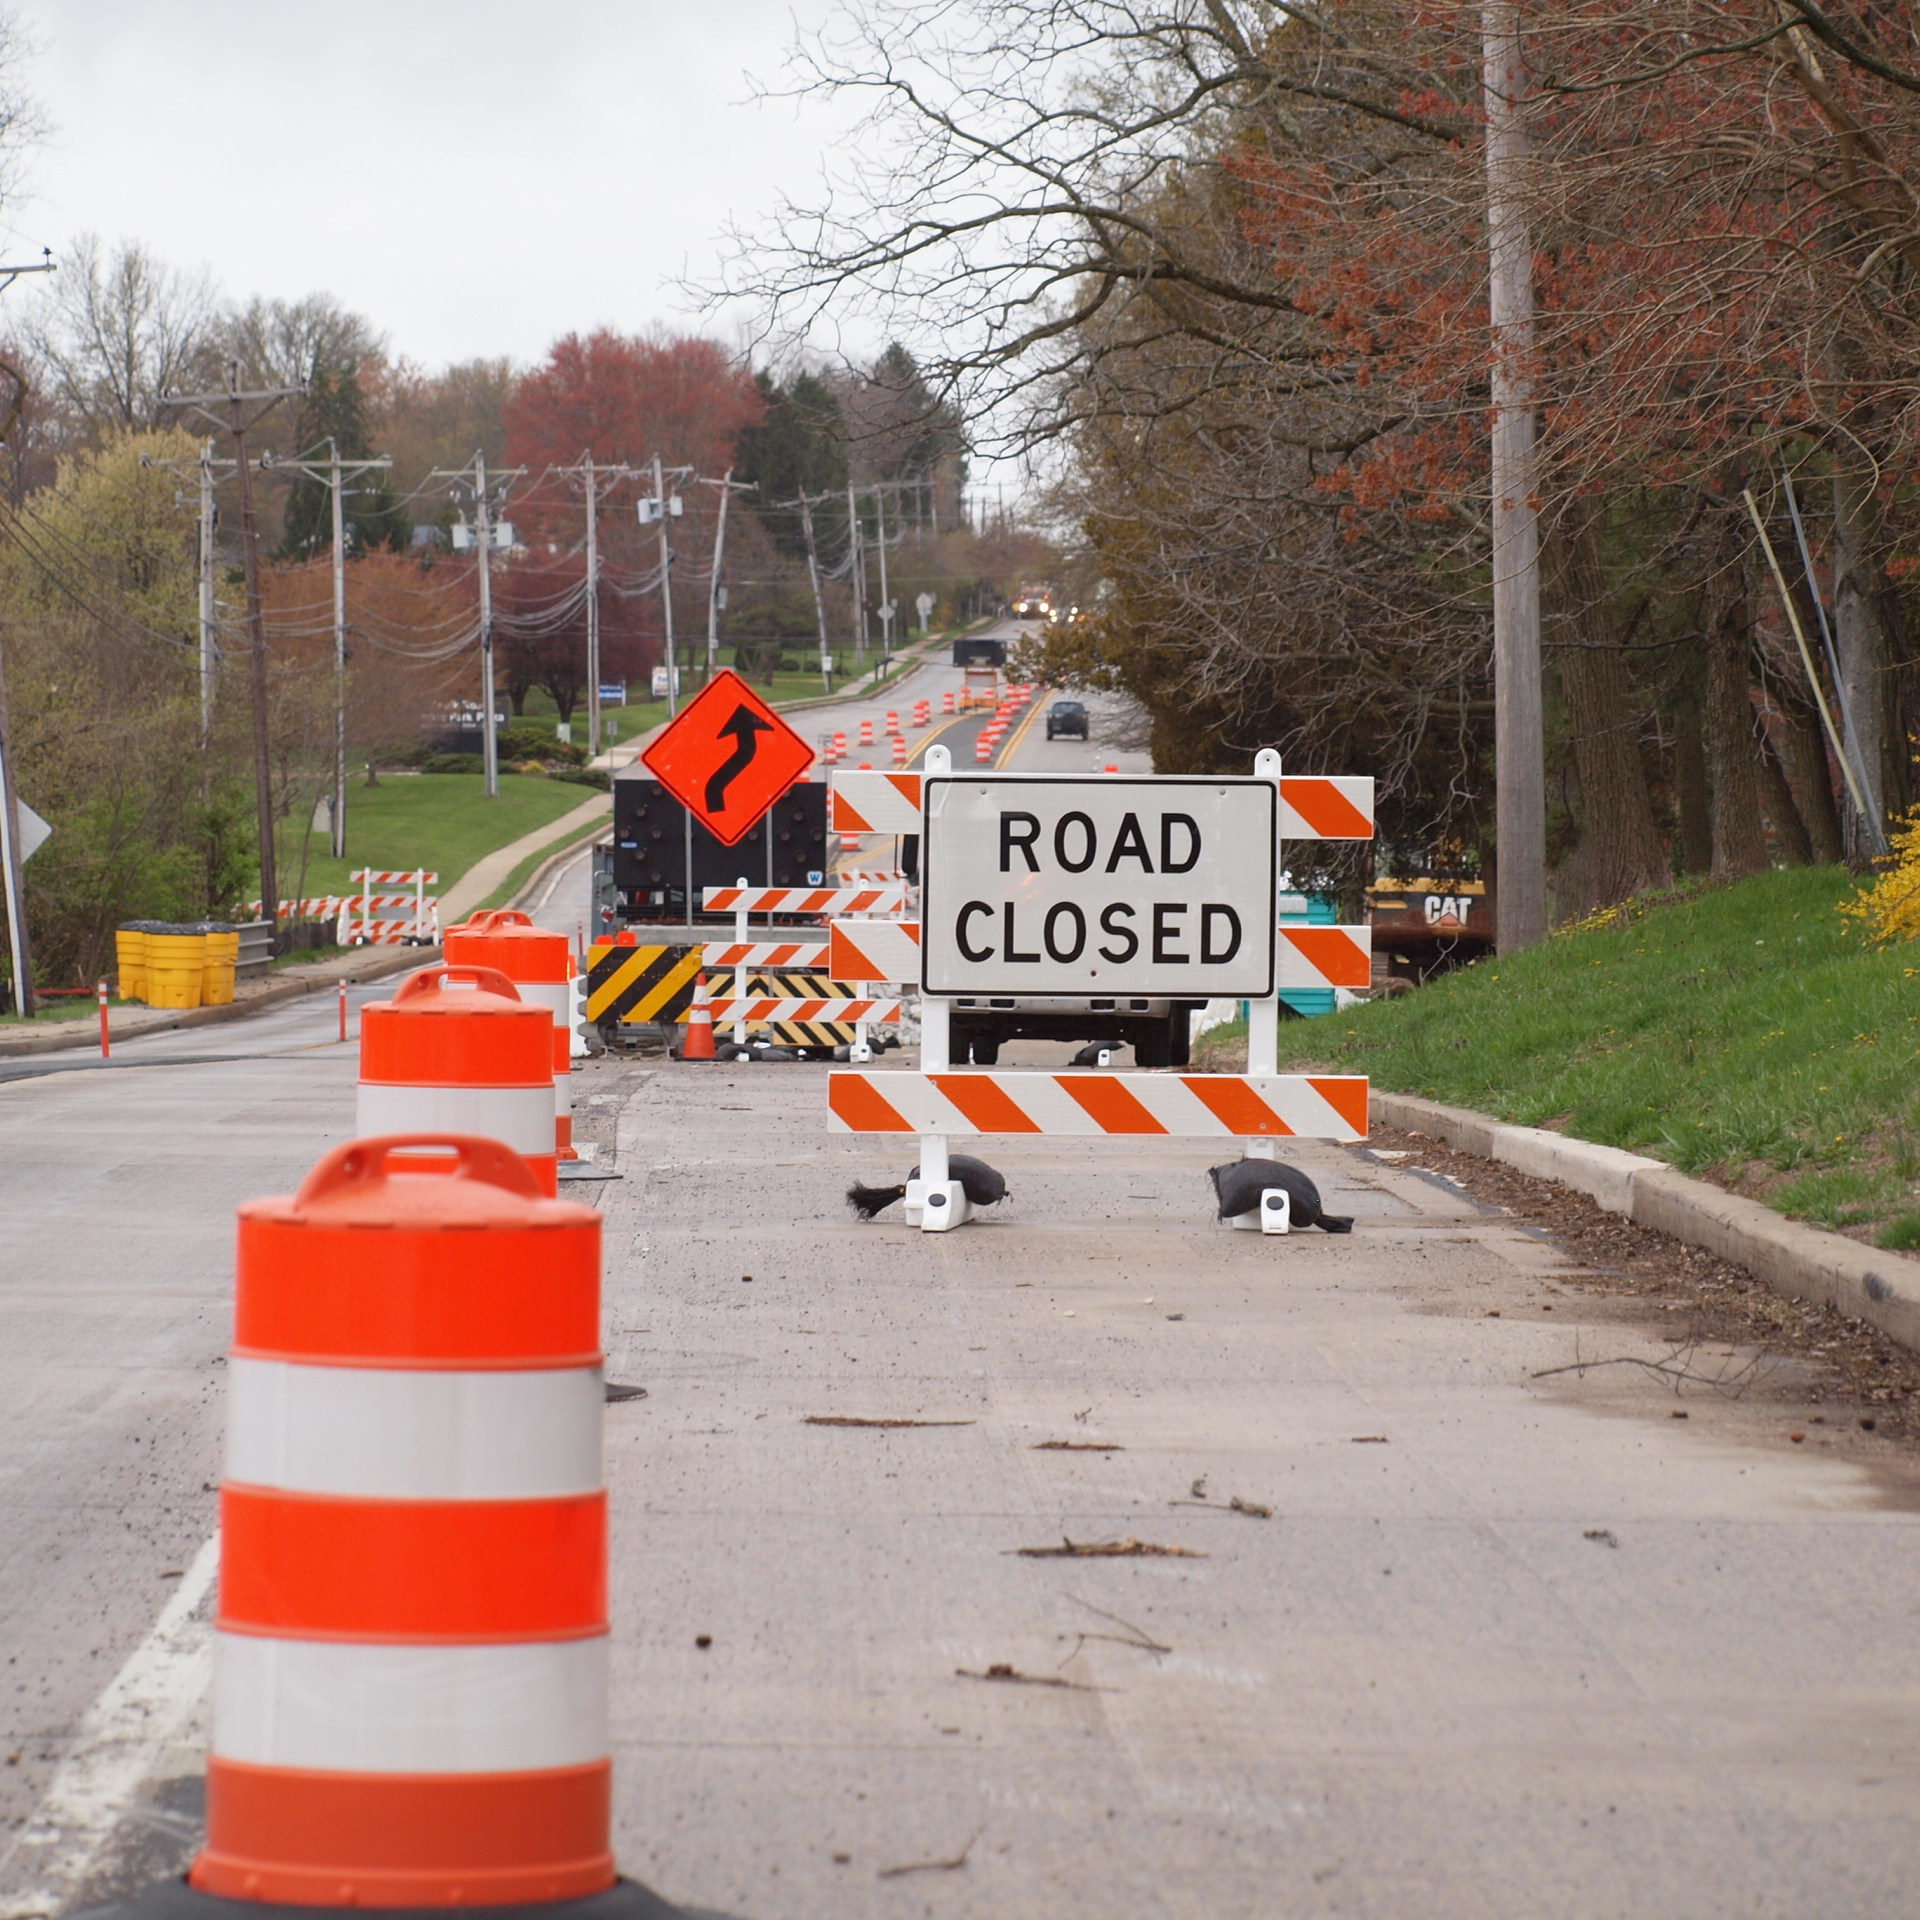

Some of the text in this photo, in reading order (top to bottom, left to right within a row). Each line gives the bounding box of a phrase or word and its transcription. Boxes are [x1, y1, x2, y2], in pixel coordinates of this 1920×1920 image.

[1000, 811, 1202, 874] ROAD
[955, 900, 1242, 964] CLOSED
[1424, 895, 1472, 926] CAT
